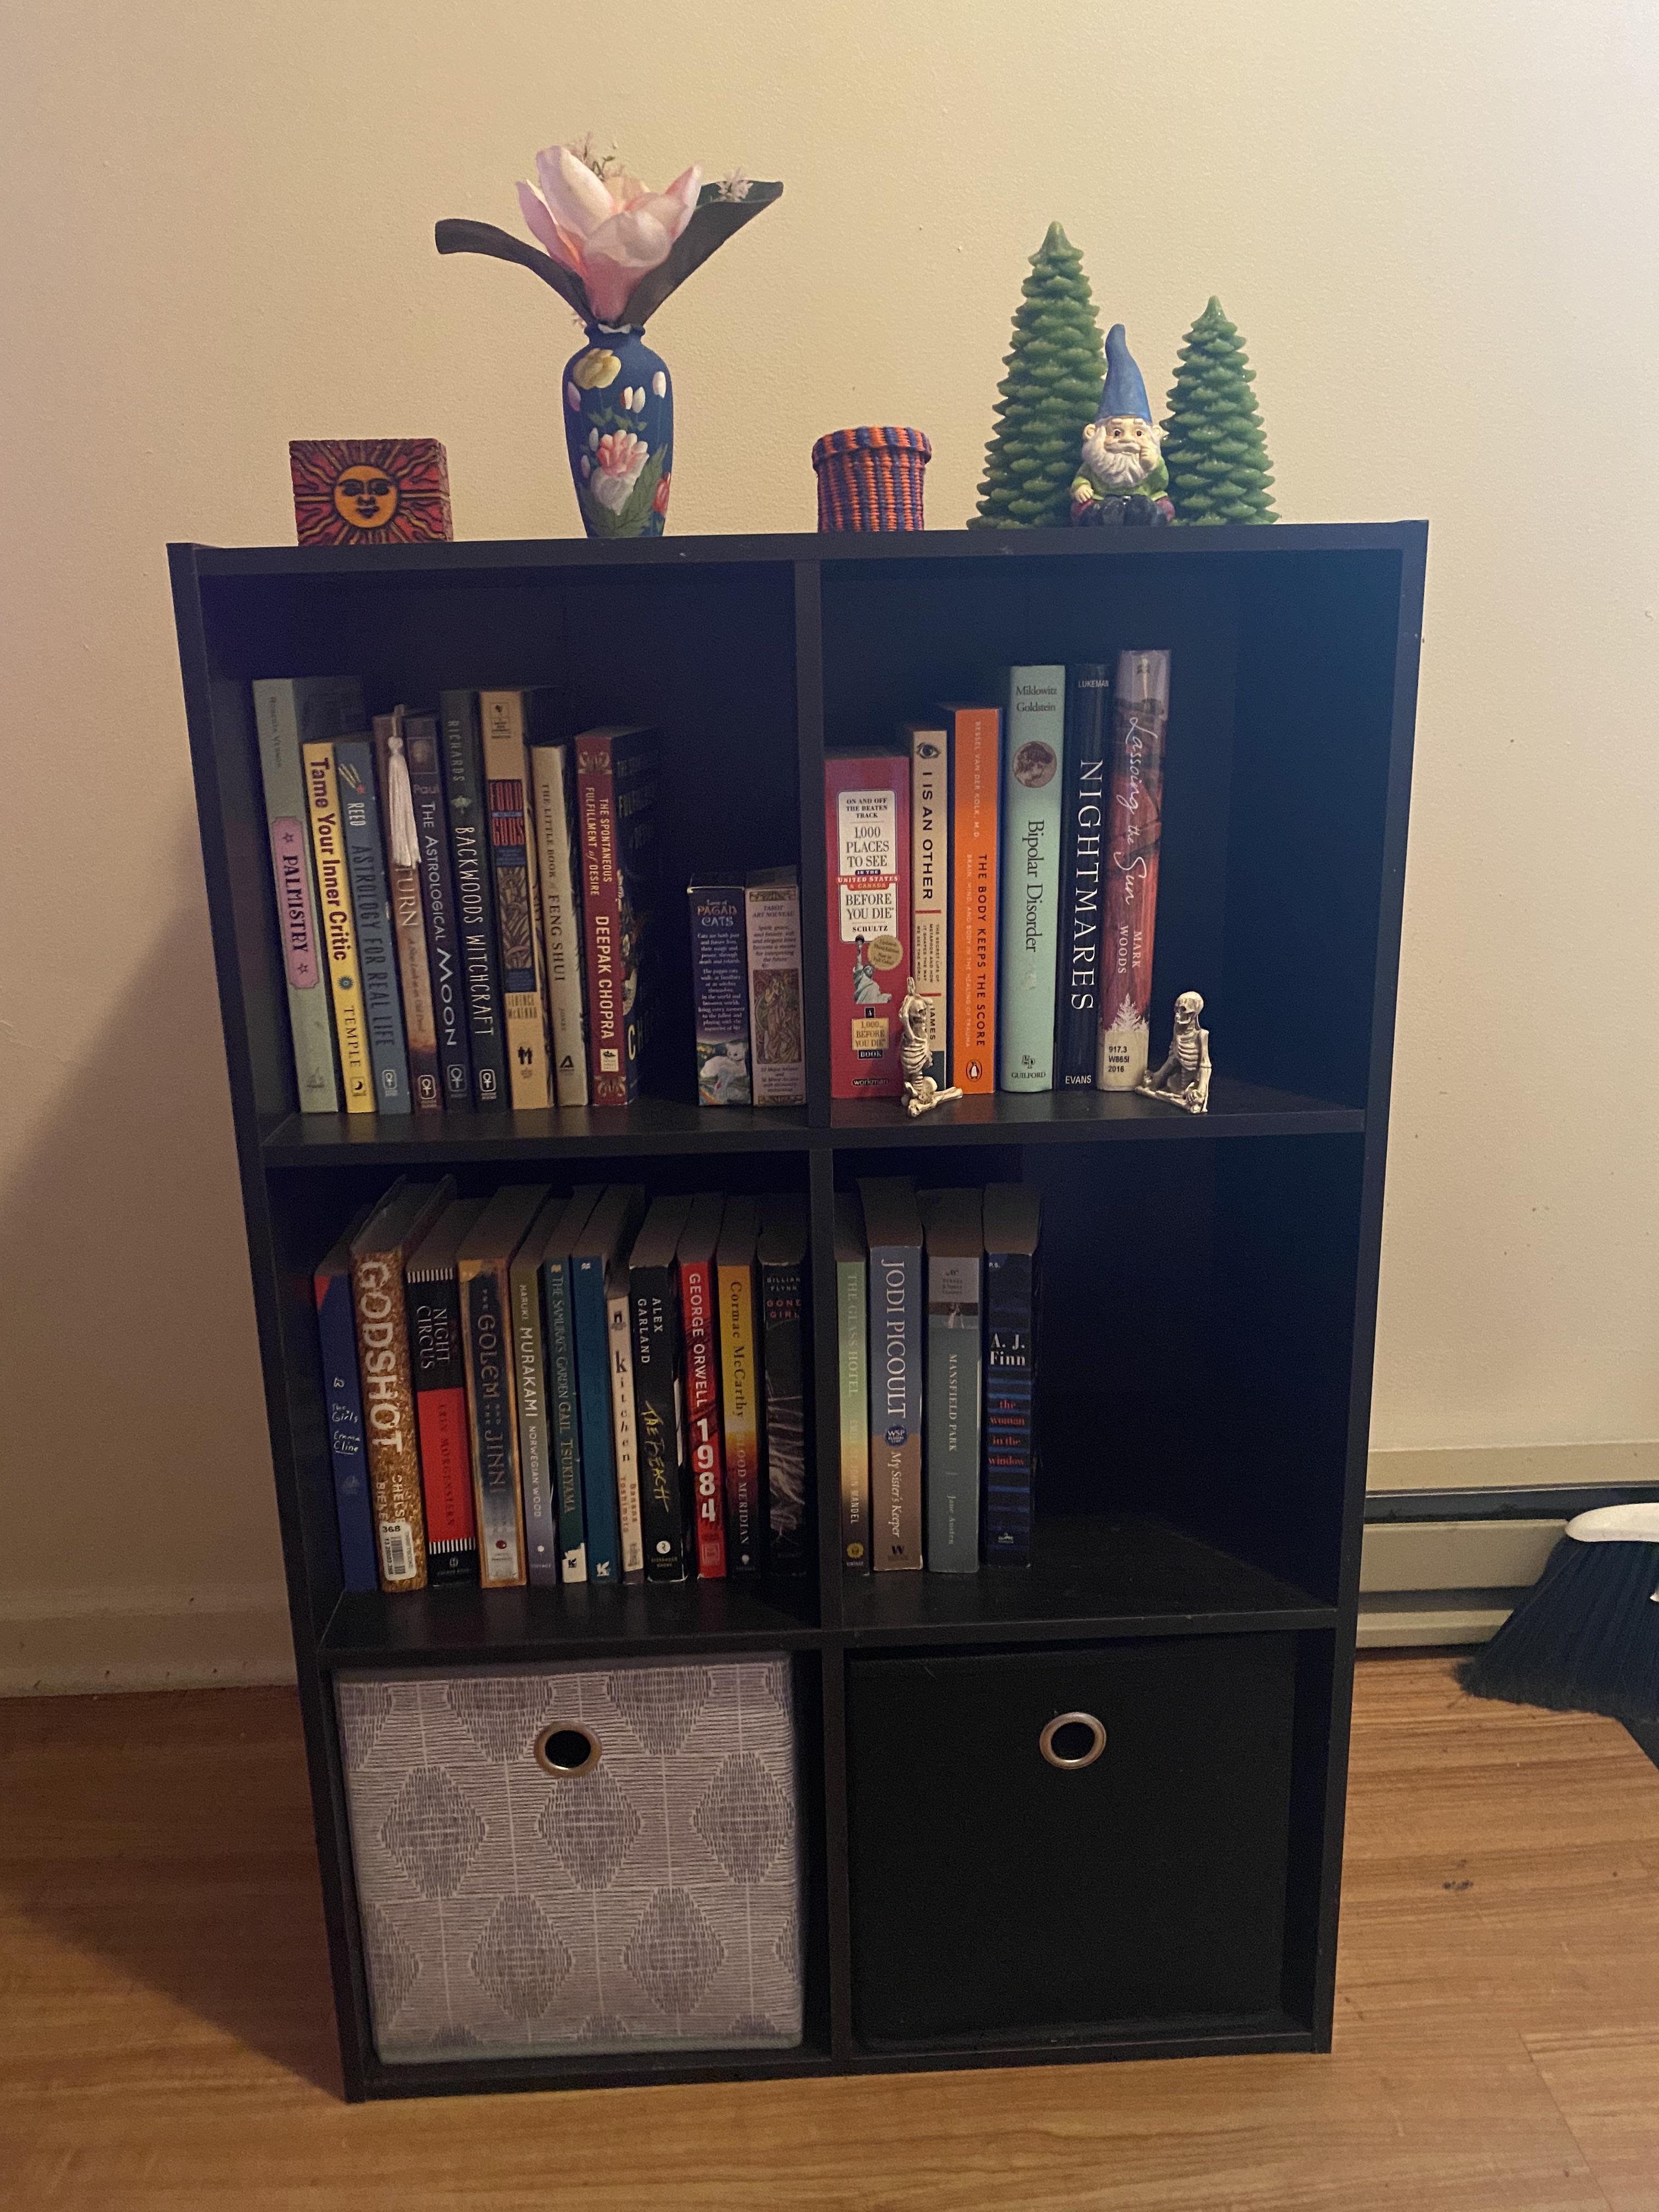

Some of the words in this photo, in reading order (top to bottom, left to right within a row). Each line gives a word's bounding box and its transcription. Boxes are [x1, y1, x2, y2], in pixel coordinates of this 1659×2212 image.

[1015, 686, 1057, 696] Miklowitz
[1016, 702, 1056, 712] Goldstein
[448, 720, 465, 781] RICHARDS
[1116, 716, 1158, 815] Lassoing
[311, 758, 329, 809] Tame
[922, 783, 933, 800] IS
[347, 803, 366, 826] REED
[421, 802, 436, 827] THE
[585, 787, 598, 848] FULFILLMENT
[600, 799, 610, 815] THE
[922, 806, 933, 831] AN
[317, 812, 336, 860] Your
[600, 818, 613, 883] SPONTANEOUS
[847, 841, 889, 854] PLACES
[1022, 820, 1045, 878] Bipolar
[1127, 824, 1141, 844] the
[455, 827, 483, 923] BACKWOODS
[547, 849, 556, 878] BOOK
[588, 850, 596, 861] of
[848, 856, 863, 867] TO
[866, 855, 888, 867] SEE
[923, 839, 933, 900] OTHER
[978, 854, 988, 878] THE
[322, 860, 341, 906] Inner
[352, 845, 381, 932] ASTROLOGY
[425, 836, 447, 940] ASTROLOGICAL
[589, 864, 600, 896] DESIRE
[1071, 759, 1103, 1009] NIGHTMARES
[1114, 851, 1148, 906] Sun
[283, 855, 308, 952] PALMISTRY
[549, 895, 562, 936] FENG
[846, 894, 892, 906] BEFORE
[847, 909, 869, 920] YOU
[978, 886, 988, 921] BODY
[1026, 884, 1043, 952] Disorder
[329, 911, 352, 961] Critic
[701, 916, 734, 927] CATS
[364, 938, 386, 967] FOR
[552, 942, 566, 981] SHUI
[595, 916, 612, 974] DEEPAK
[977, 928, 986, 967] KEEPS
[1117, 924, 1128, 974] WOODS
[1132, 931, 1142, 968] MARK
[368, 972, 389, 1013] REAL
[437, 947, 456, 1046] MOON
[466, 935, 493, 1036] WITCHCRAFT
[977, 974, 986, 998] THE
[600, 980, 615, 1039] CHOPRA
[977, 1004, 986, 1046] SCORE
[344, 1005, 362, 1067] TEMPLE
[373, 1015, 395, 1046] LIFE
[856, 1030, 885, 1039] BEFORE
[1065, 1075, 1092, 1085] EVANS
[520, 1284, 531, 1319] HARUKI
[552, 1277, 564, 1296] THE
[689, 1273, 704, 1338] GEORGE
[767, 1299, 802, 1307] GONE
[881, 1259, 905, 1314] JODI
[652, 1298, 663, 1333] ALEX
[731, 1281, 742, 1339] Cormac
[770, 1311, 799, 1319] GIRL
[417, 1305, 435, 1369] CIRCUS
[433, 1307, 450, 1362] NIGHT
[637, 1298, 650, 1364] GARLAND
[991, 1333, 1006, 1348] A.
[1012, 1334, 1025, 1350] J.
[357, 1261, 403, 1455] GODSHOT
[520, 1327, 539, 1417] MURAKAMI
[555, 1356, 569, 1399] GARDEN
[693, 1344, 708, 1408] ORWELL
[849, 1351, 859, 1397] HOTEL
[887, 1320, 906, 1419] PICOULT
[990, 1351, 1026, 1366] Finn
[732, 1346, 747, 1418] McCarthy
[949, 1353, 957, 1420] MANSFIELD
[331, 1410, 359, 1423] Girls
[558, 1402, 572, 1433] GAIL
[990, 1417, 1025, 1426] woman
[1000, 1400, 1017, 1409] the
[334, 1431, 360, 1441] Emma
[334, 1441, 359, 1452] Cline
[529, 1426, 539, 1485] NORWEGIAN
[948, 1424, 957, 1452] PARK
[992, 1436, 1003, 1445] in
[1005, 1436, 1021, 1445] the
[485, 1429, 506, 1493] JINNI
[560, 1438, 576, 1514] TSUKIYAMA
[697, 1418, 716, 1522] 1984
[736, 1436, 747, 1477] BLOOD
[888, 1452, 901, 1468] My
[988, 1455, 1024, 1466] window
[532, 1488, 541, 1517] WOOD
[891, 1471, 904, 1502] Sister's
[947, 1495, 956, 1515] Jane
[738, 1482, 750, 1545] MERIDIAN
[850, 1489, 859, 1525] MANDEL
[888, 1505, 902, 1538] Keeper
